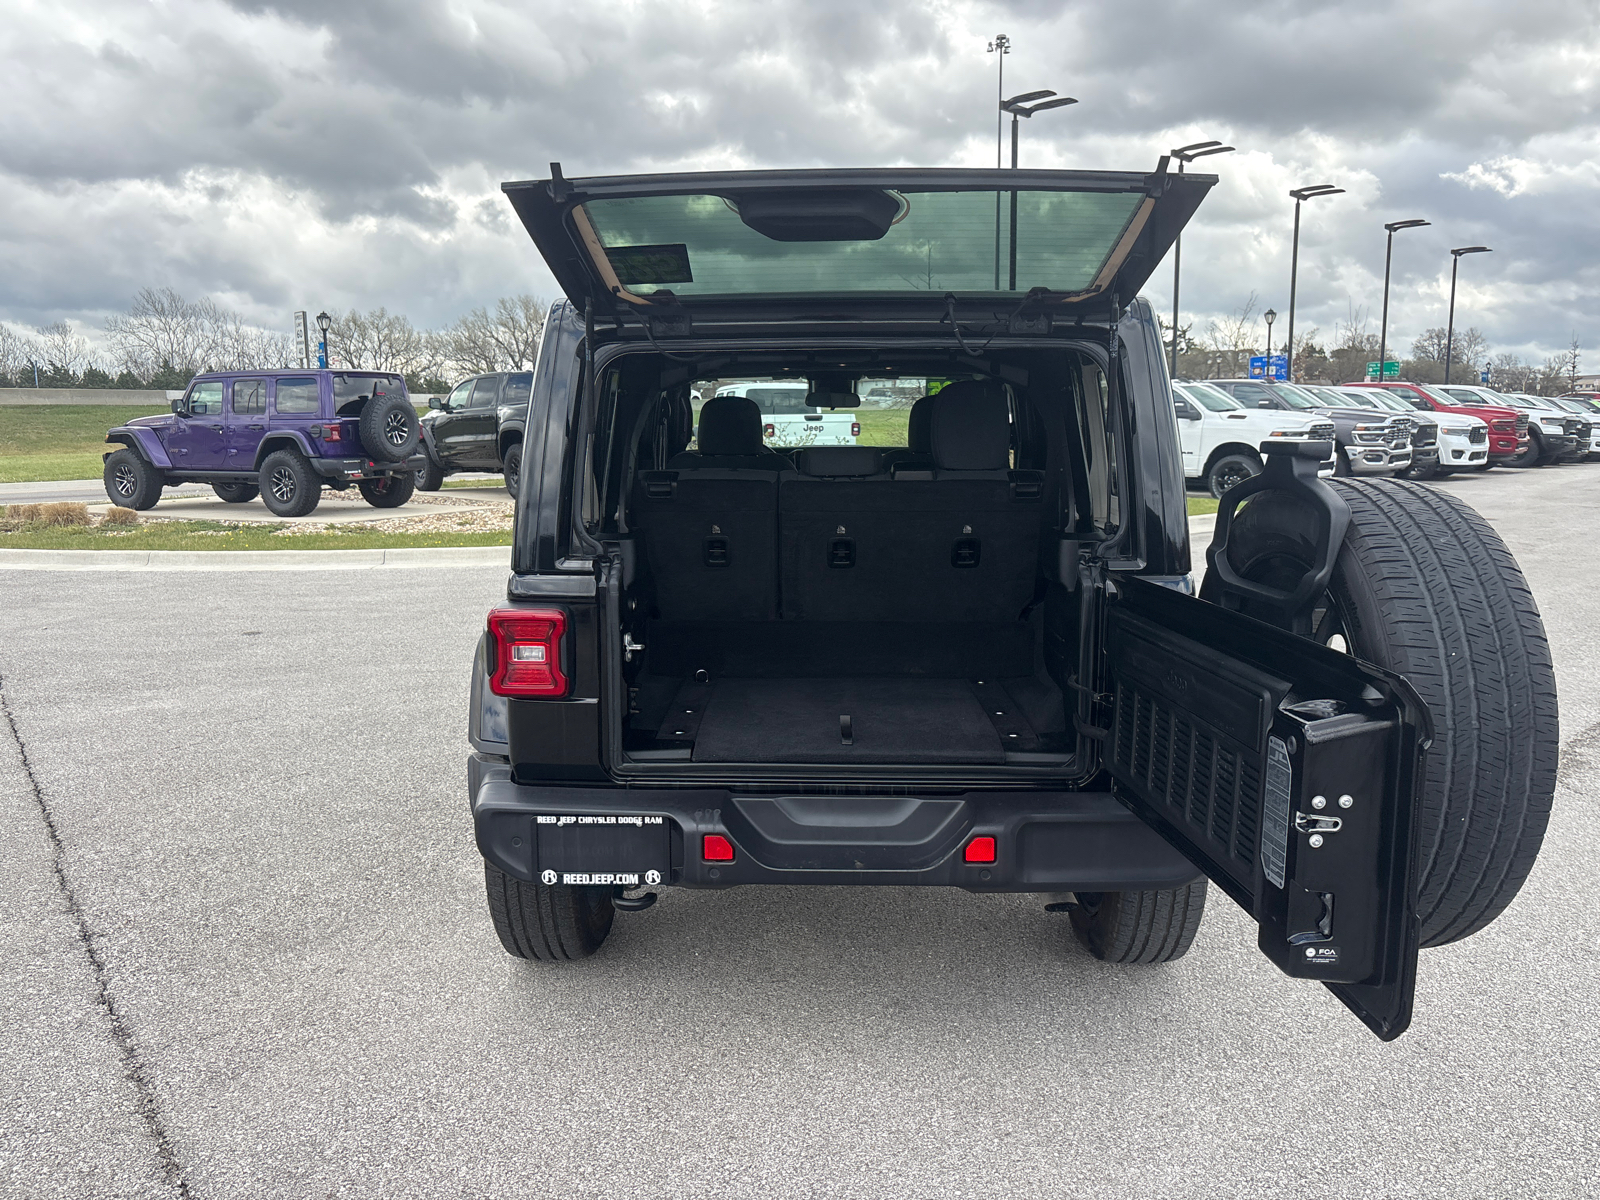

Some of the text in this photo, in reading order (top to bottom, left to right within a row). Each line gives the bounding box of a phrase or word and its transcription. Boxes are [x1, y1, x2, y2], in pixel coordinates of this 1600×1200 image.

[803, 424, 824, 433] Jeep
[1270, 750, 1287, 764] JL
[537, 816, 662, 824] REED JEEP CHRYSLER DODGE RAM
[563, 874, 639, 884] REEDJEEP.COM
